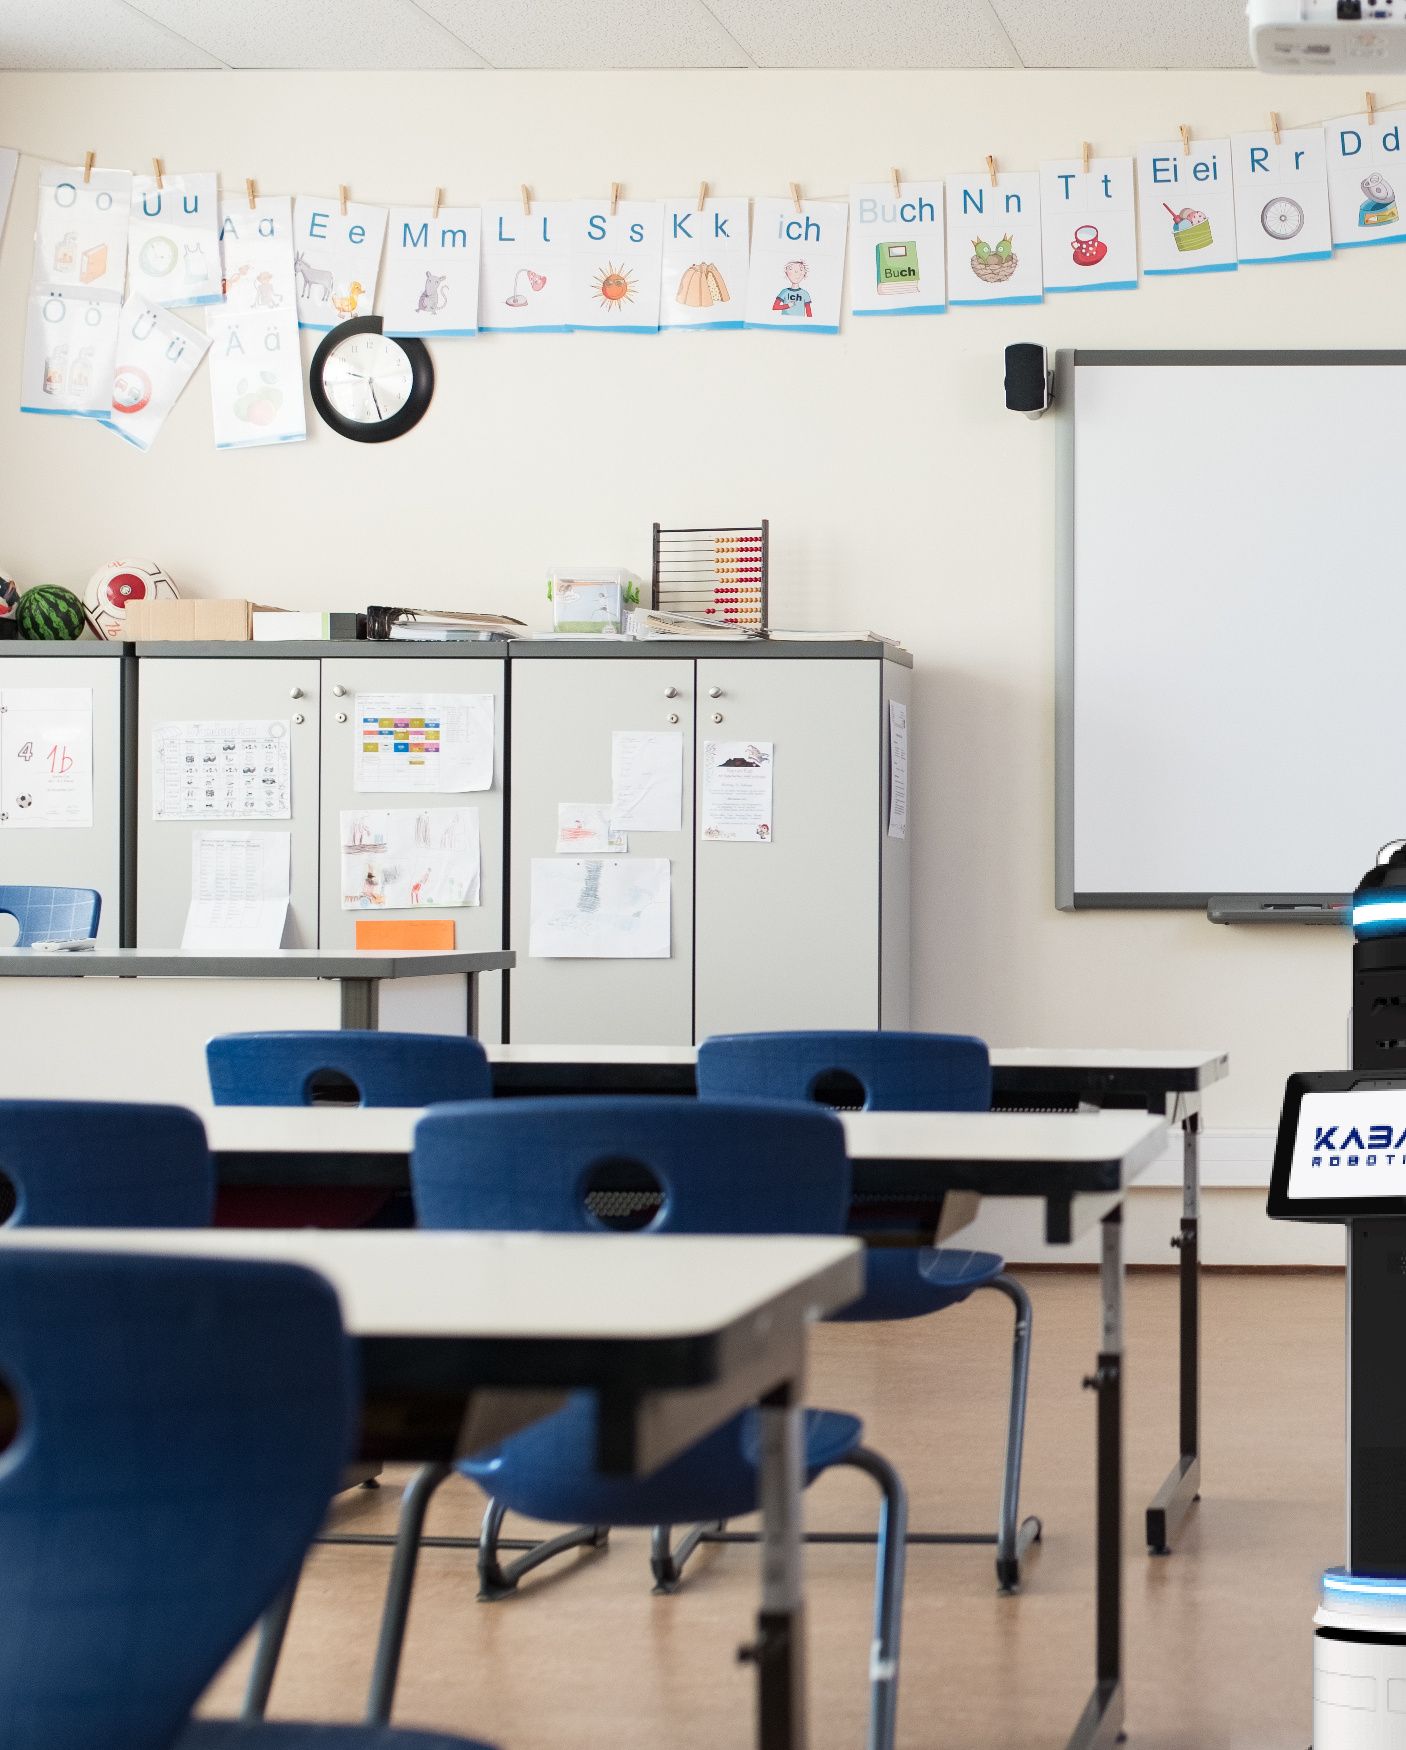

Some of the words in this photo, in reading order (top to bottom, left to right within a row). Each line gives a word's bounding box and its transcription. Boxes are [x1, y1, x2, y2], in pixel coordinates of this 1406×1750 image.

[1341, 131, 1362, 156] D
[1383, 126, 1400, 151] d
[1250, 148, 1269, 172] R
[1295, 151, 1304, 170] r
[55, 183, 77, 208] O
[96, 192, 112, 211] o
[1058, 175, 1075, 199] T
[1102, 175, 1112, 198] t
[143, 193, 161, 217] U
[184, 195, 198, 214] u
[859, 198, 935, 224] Buch
[963, 189, 983, 214] N
[1006, 194, 1021, 213] n
[219, 216, 239, 241] A
[259, 218, 274, 237] a
[310, 212, 329, 238] E
[349, 226, 365, 244] e
[403, 223, 428, 247] M
[441, 229, 466, 247] m
[499, 217, 515, 241] L
[588, 215, 606, 240] S
[630, 224, 643, 242] s
[674, 214, 693, 238] K
[714, 213, 730, 238] k
[778, 214, 821, 242] ich
[885, 267, 915, 278] Buch
[18, 742, 33, 761] 4
[47, 745, 73, 773] 1b
